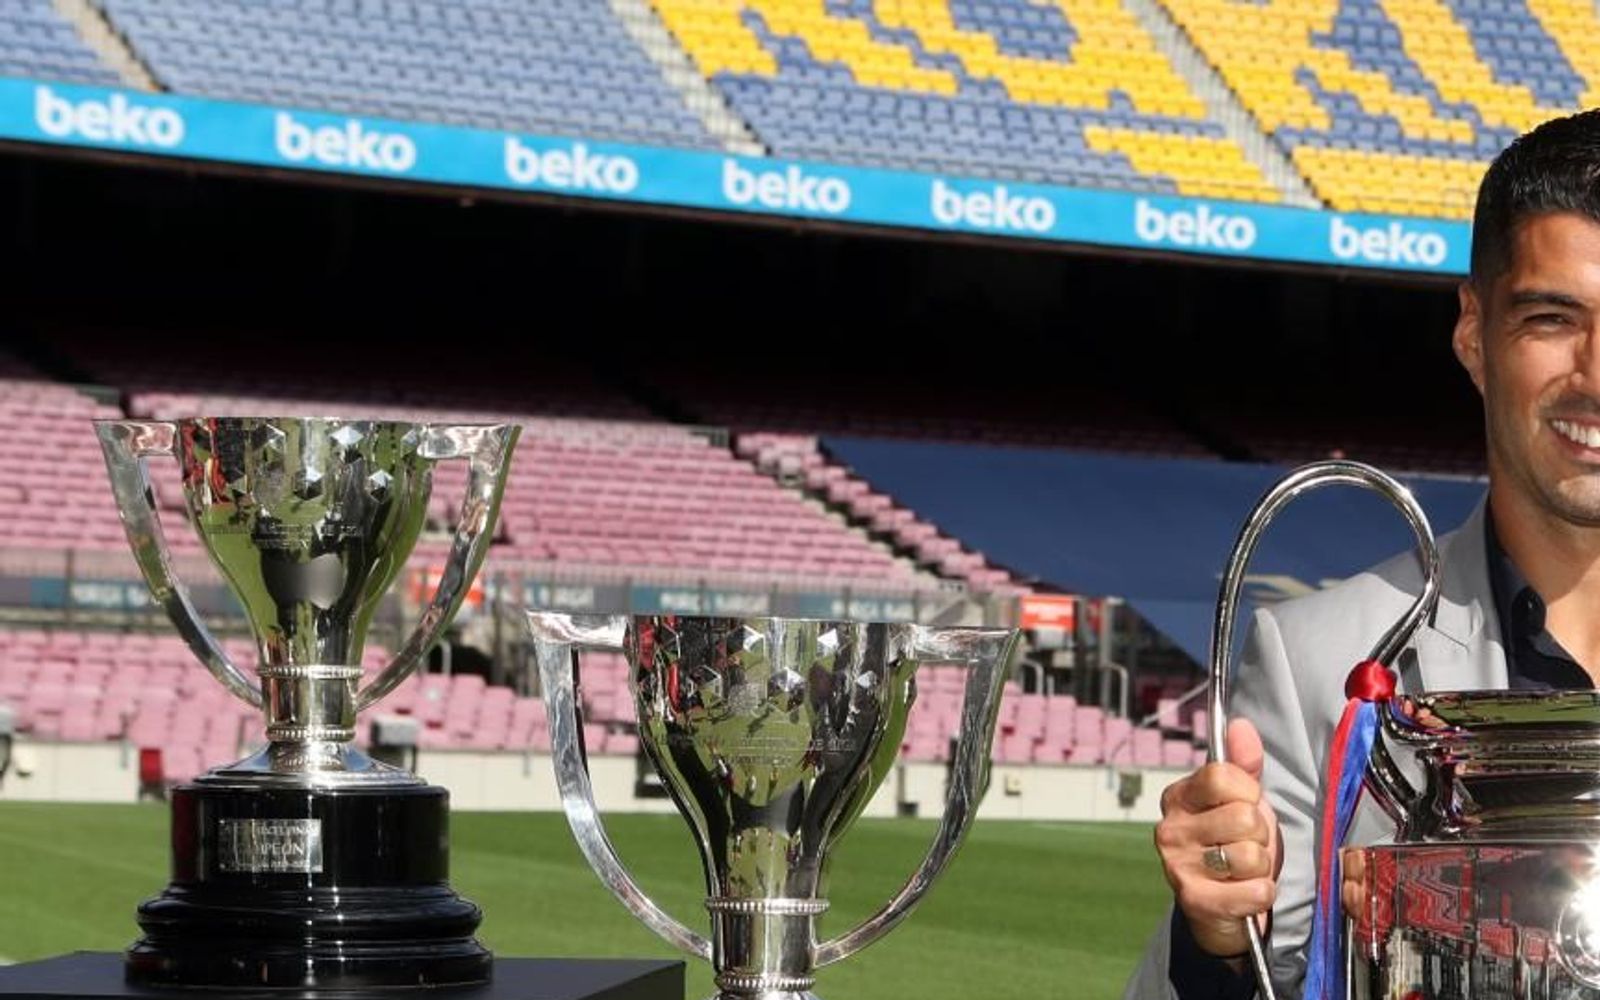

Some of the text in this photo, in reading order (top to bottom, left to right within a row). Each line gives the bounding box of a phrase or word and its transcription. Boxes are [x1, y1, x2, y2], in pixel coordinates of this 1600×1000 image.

[36, 86, 184, 147] beko
[276, 111, 416, 171] beko
[504, 137, 638, 192] beko
[723, 158, 851, 213] beko
[931, 179, 1056, 232] beko
[1135, 199, 1256, 249] beko
[1330, 216, 1447, 266] beko
